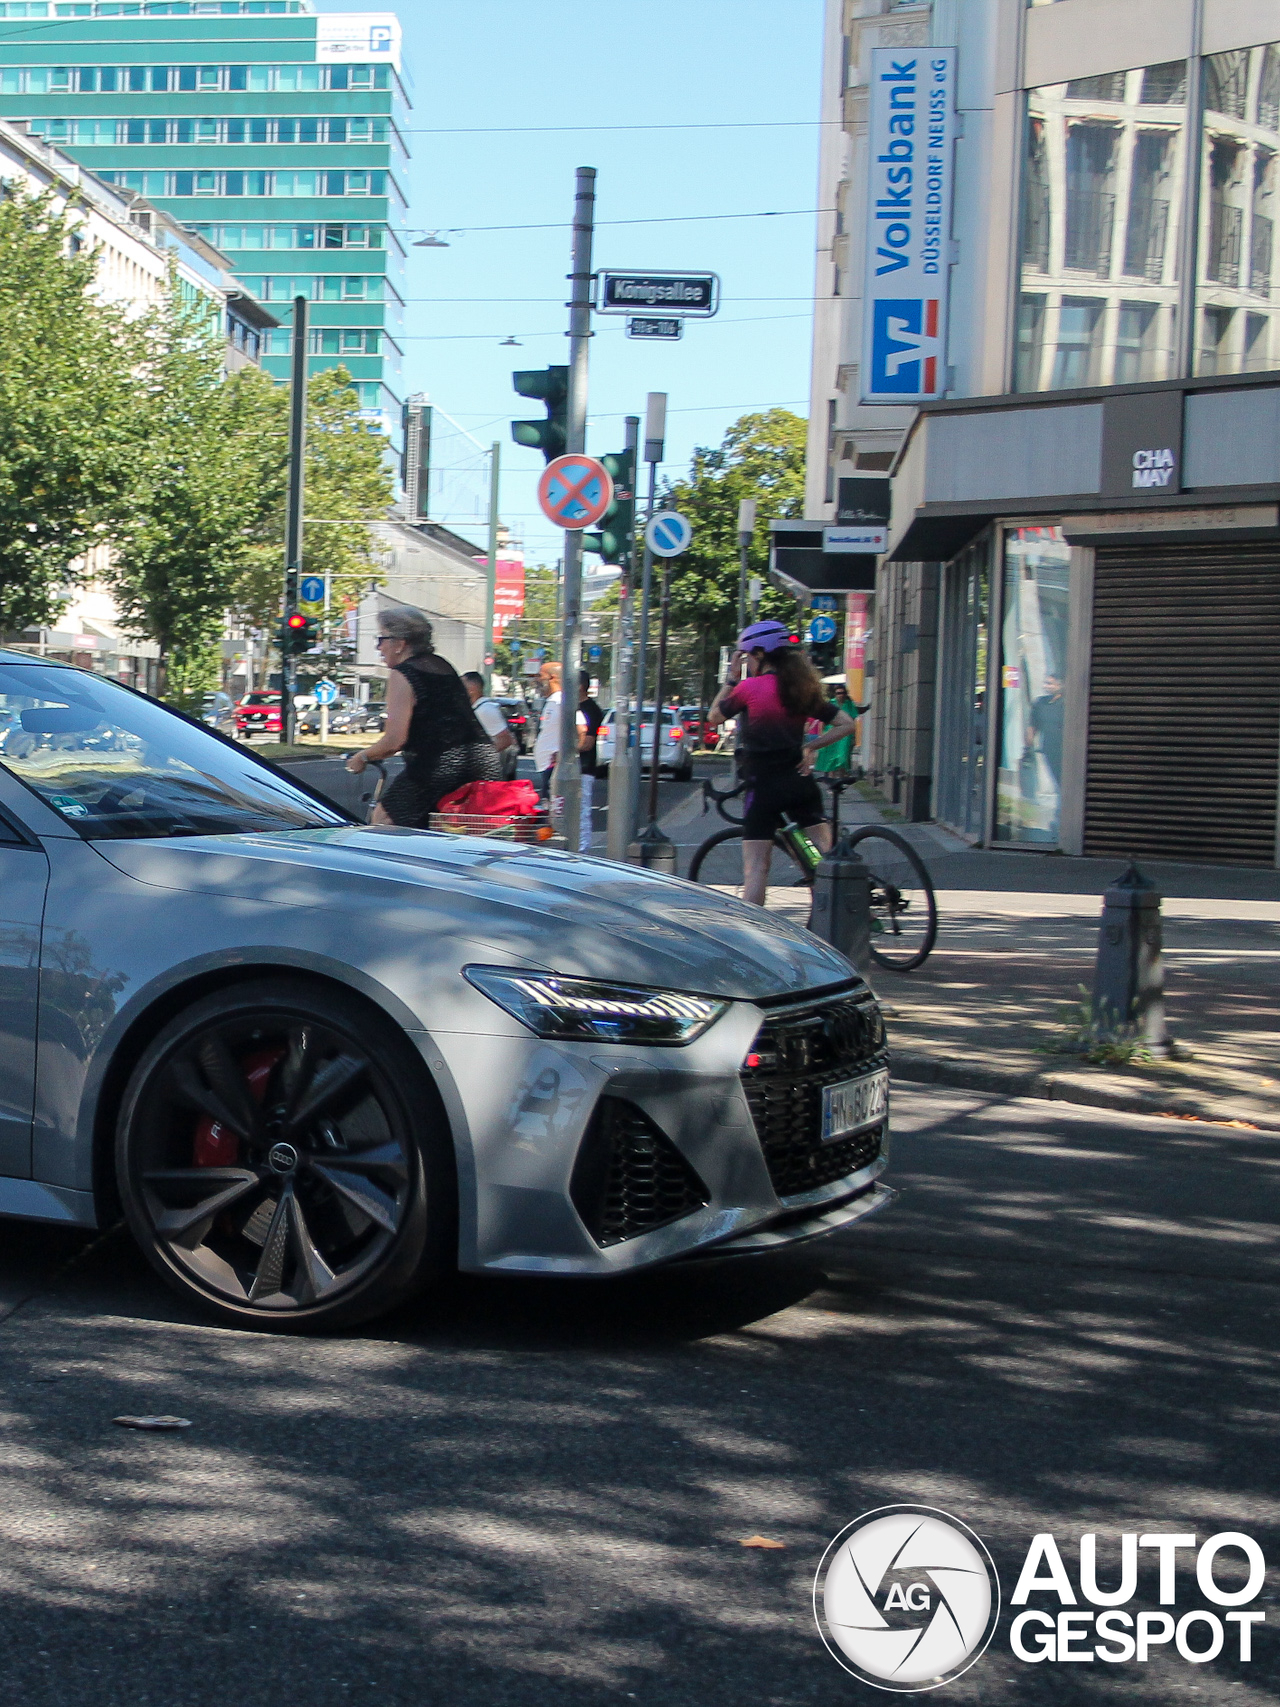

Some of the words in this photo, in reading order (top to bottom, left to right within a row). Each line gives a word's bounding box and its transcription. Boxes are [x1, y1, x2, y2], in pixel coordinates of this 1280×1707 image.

[930, 59, 948, 83] eG
[928, 89, 946, 149] NEUSS
[875, 59, 917, 276] Volksbank
[921, 154, 944, 275] DÜSSELDORF
[614, 280, 703, 304] Königsallee
[1132, 448, 1175, 470] CHA
[1132, 468, 1173, 488] MAY
